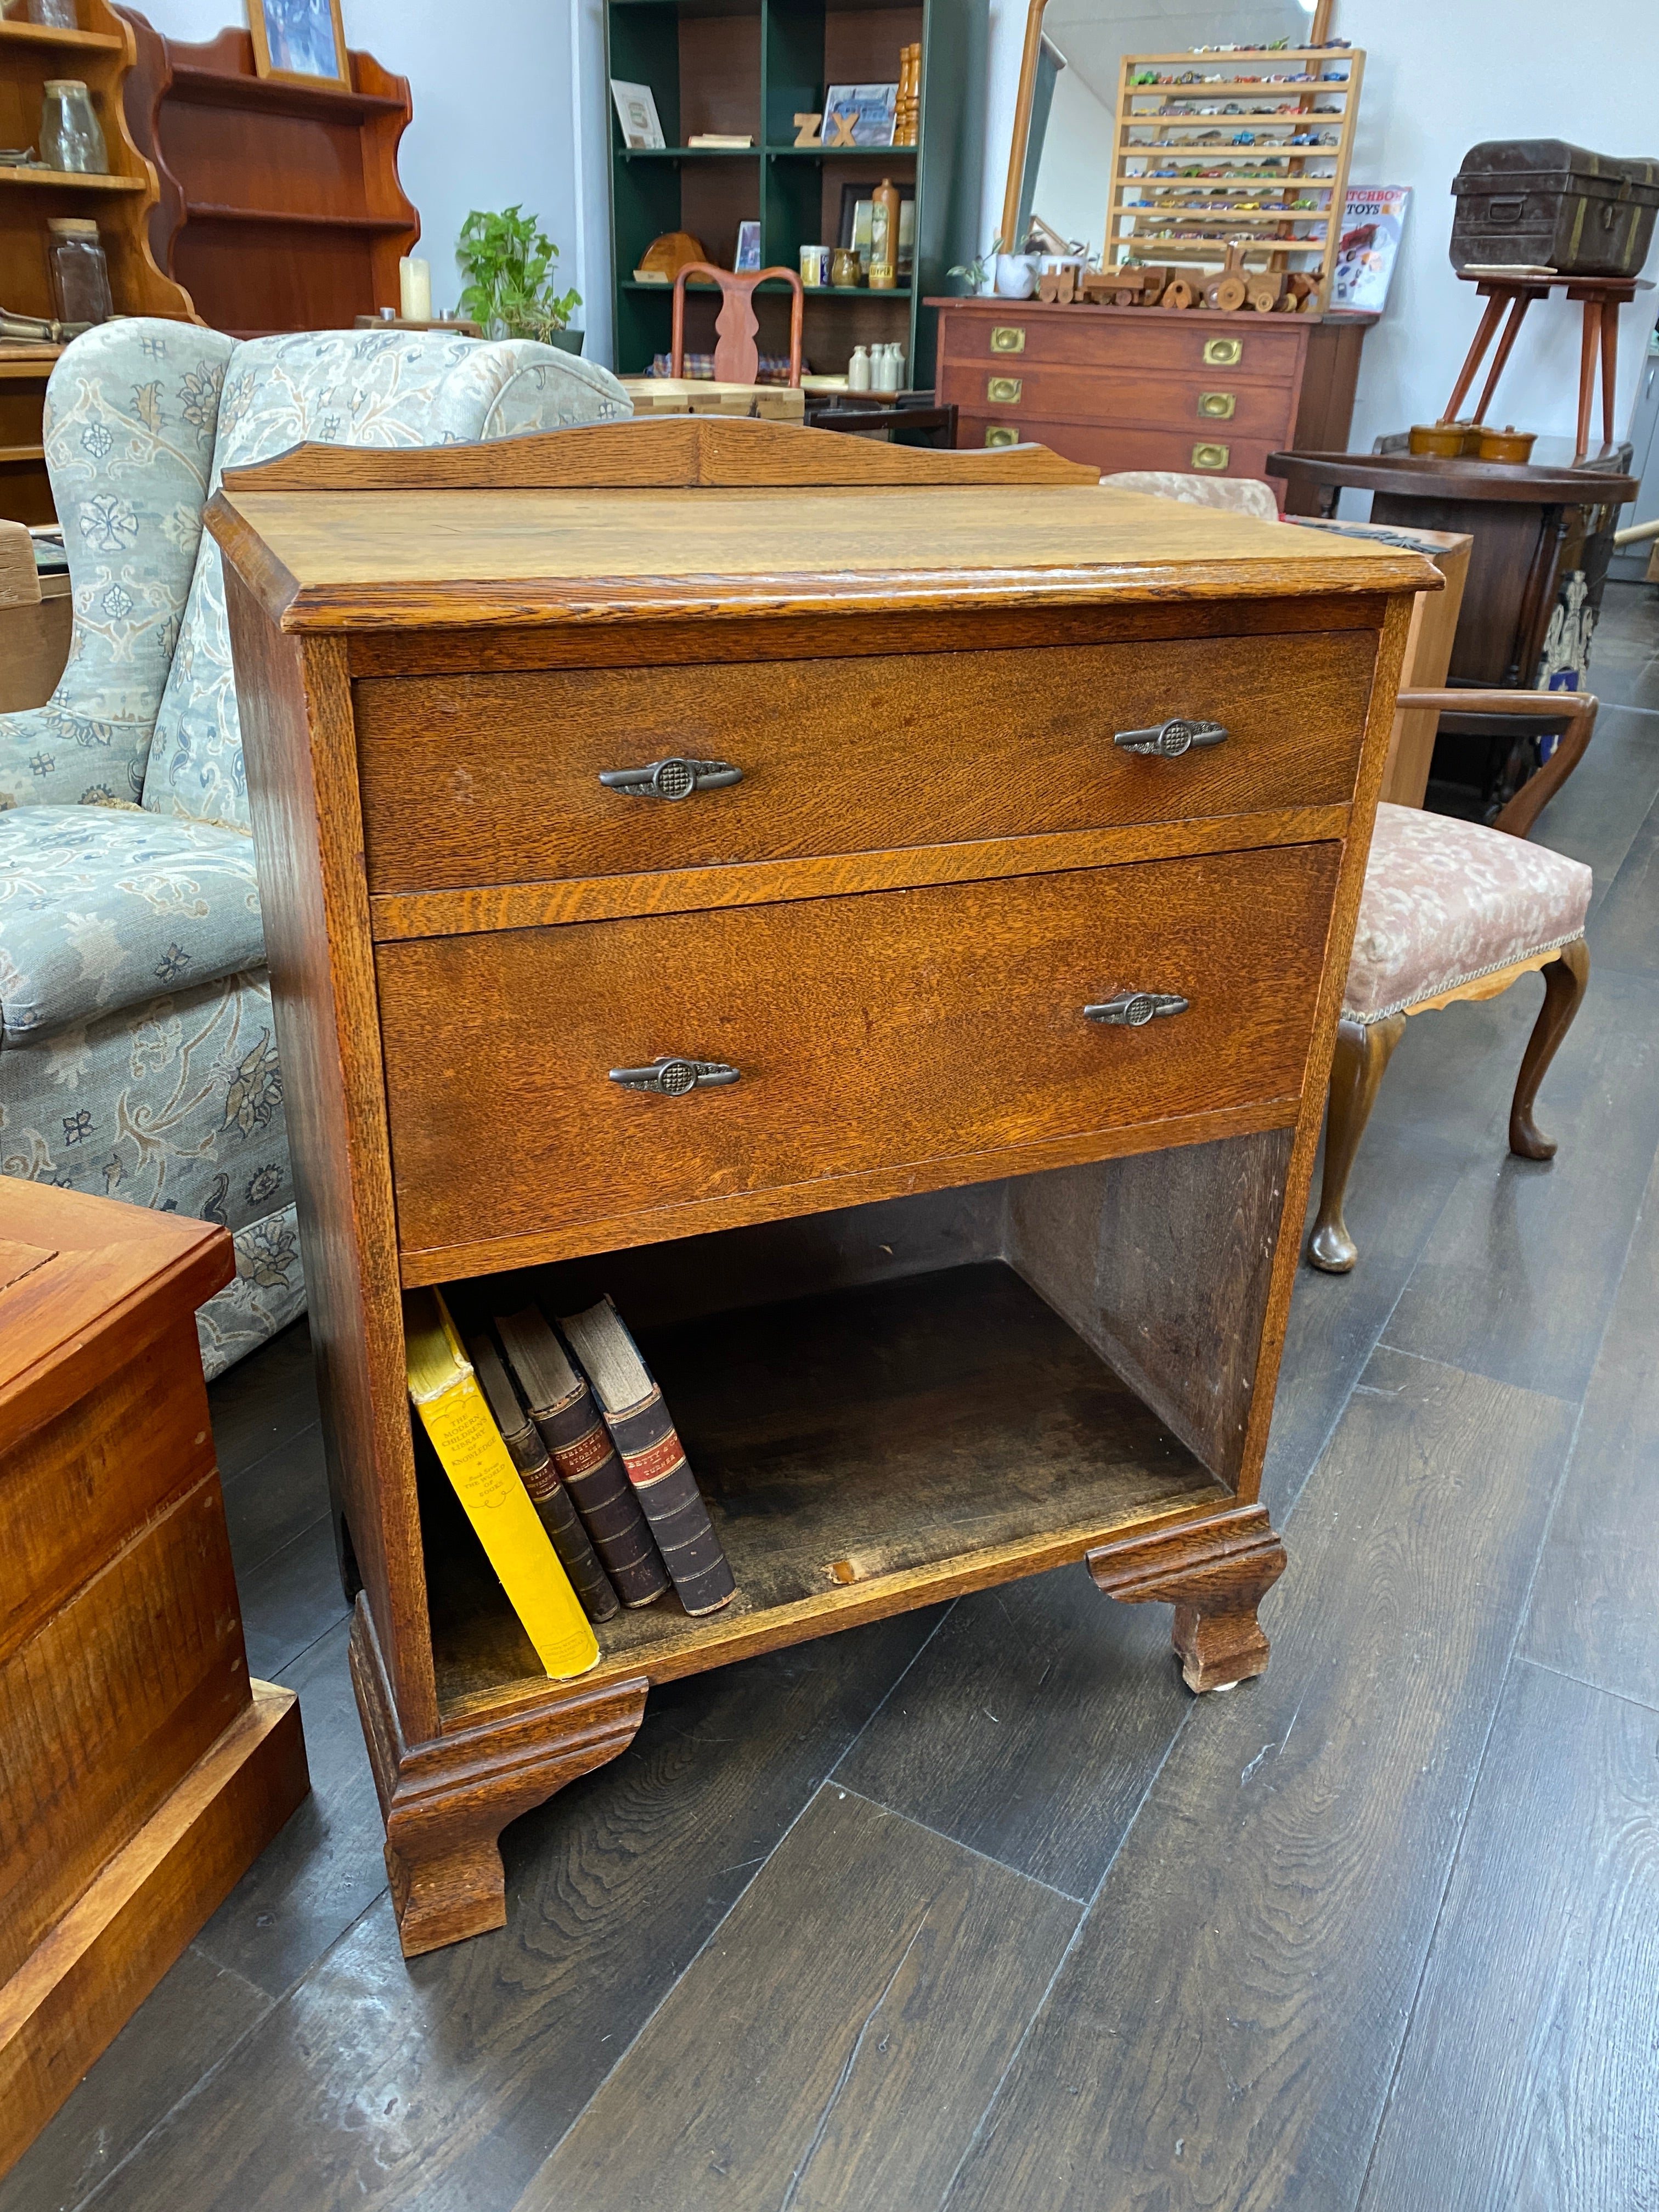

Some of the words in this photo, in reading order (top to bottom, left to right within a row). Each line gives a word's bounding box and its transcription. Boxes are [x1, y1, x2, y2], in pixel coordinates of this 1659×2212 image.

[1347, 204, 1380, 215] TOYS
[443, 1414, 479, 1438] MODERN
[450, 1413, 469, 1427] THE
[451, 1427, 486, 1452] LIBRARY
[468, 1442, 477, 1451] OF
[451, 1436, 496, 1466] KNOWLEDGE
[569, 1443, 601, 1465] STORIES
[627, 1450, 660, 1469] BETTY
[644, 1454, 675, 1476] TURNER
[464, 1481, 480, 1489] THE
[481, 1464, 505, 1482] WORLD
